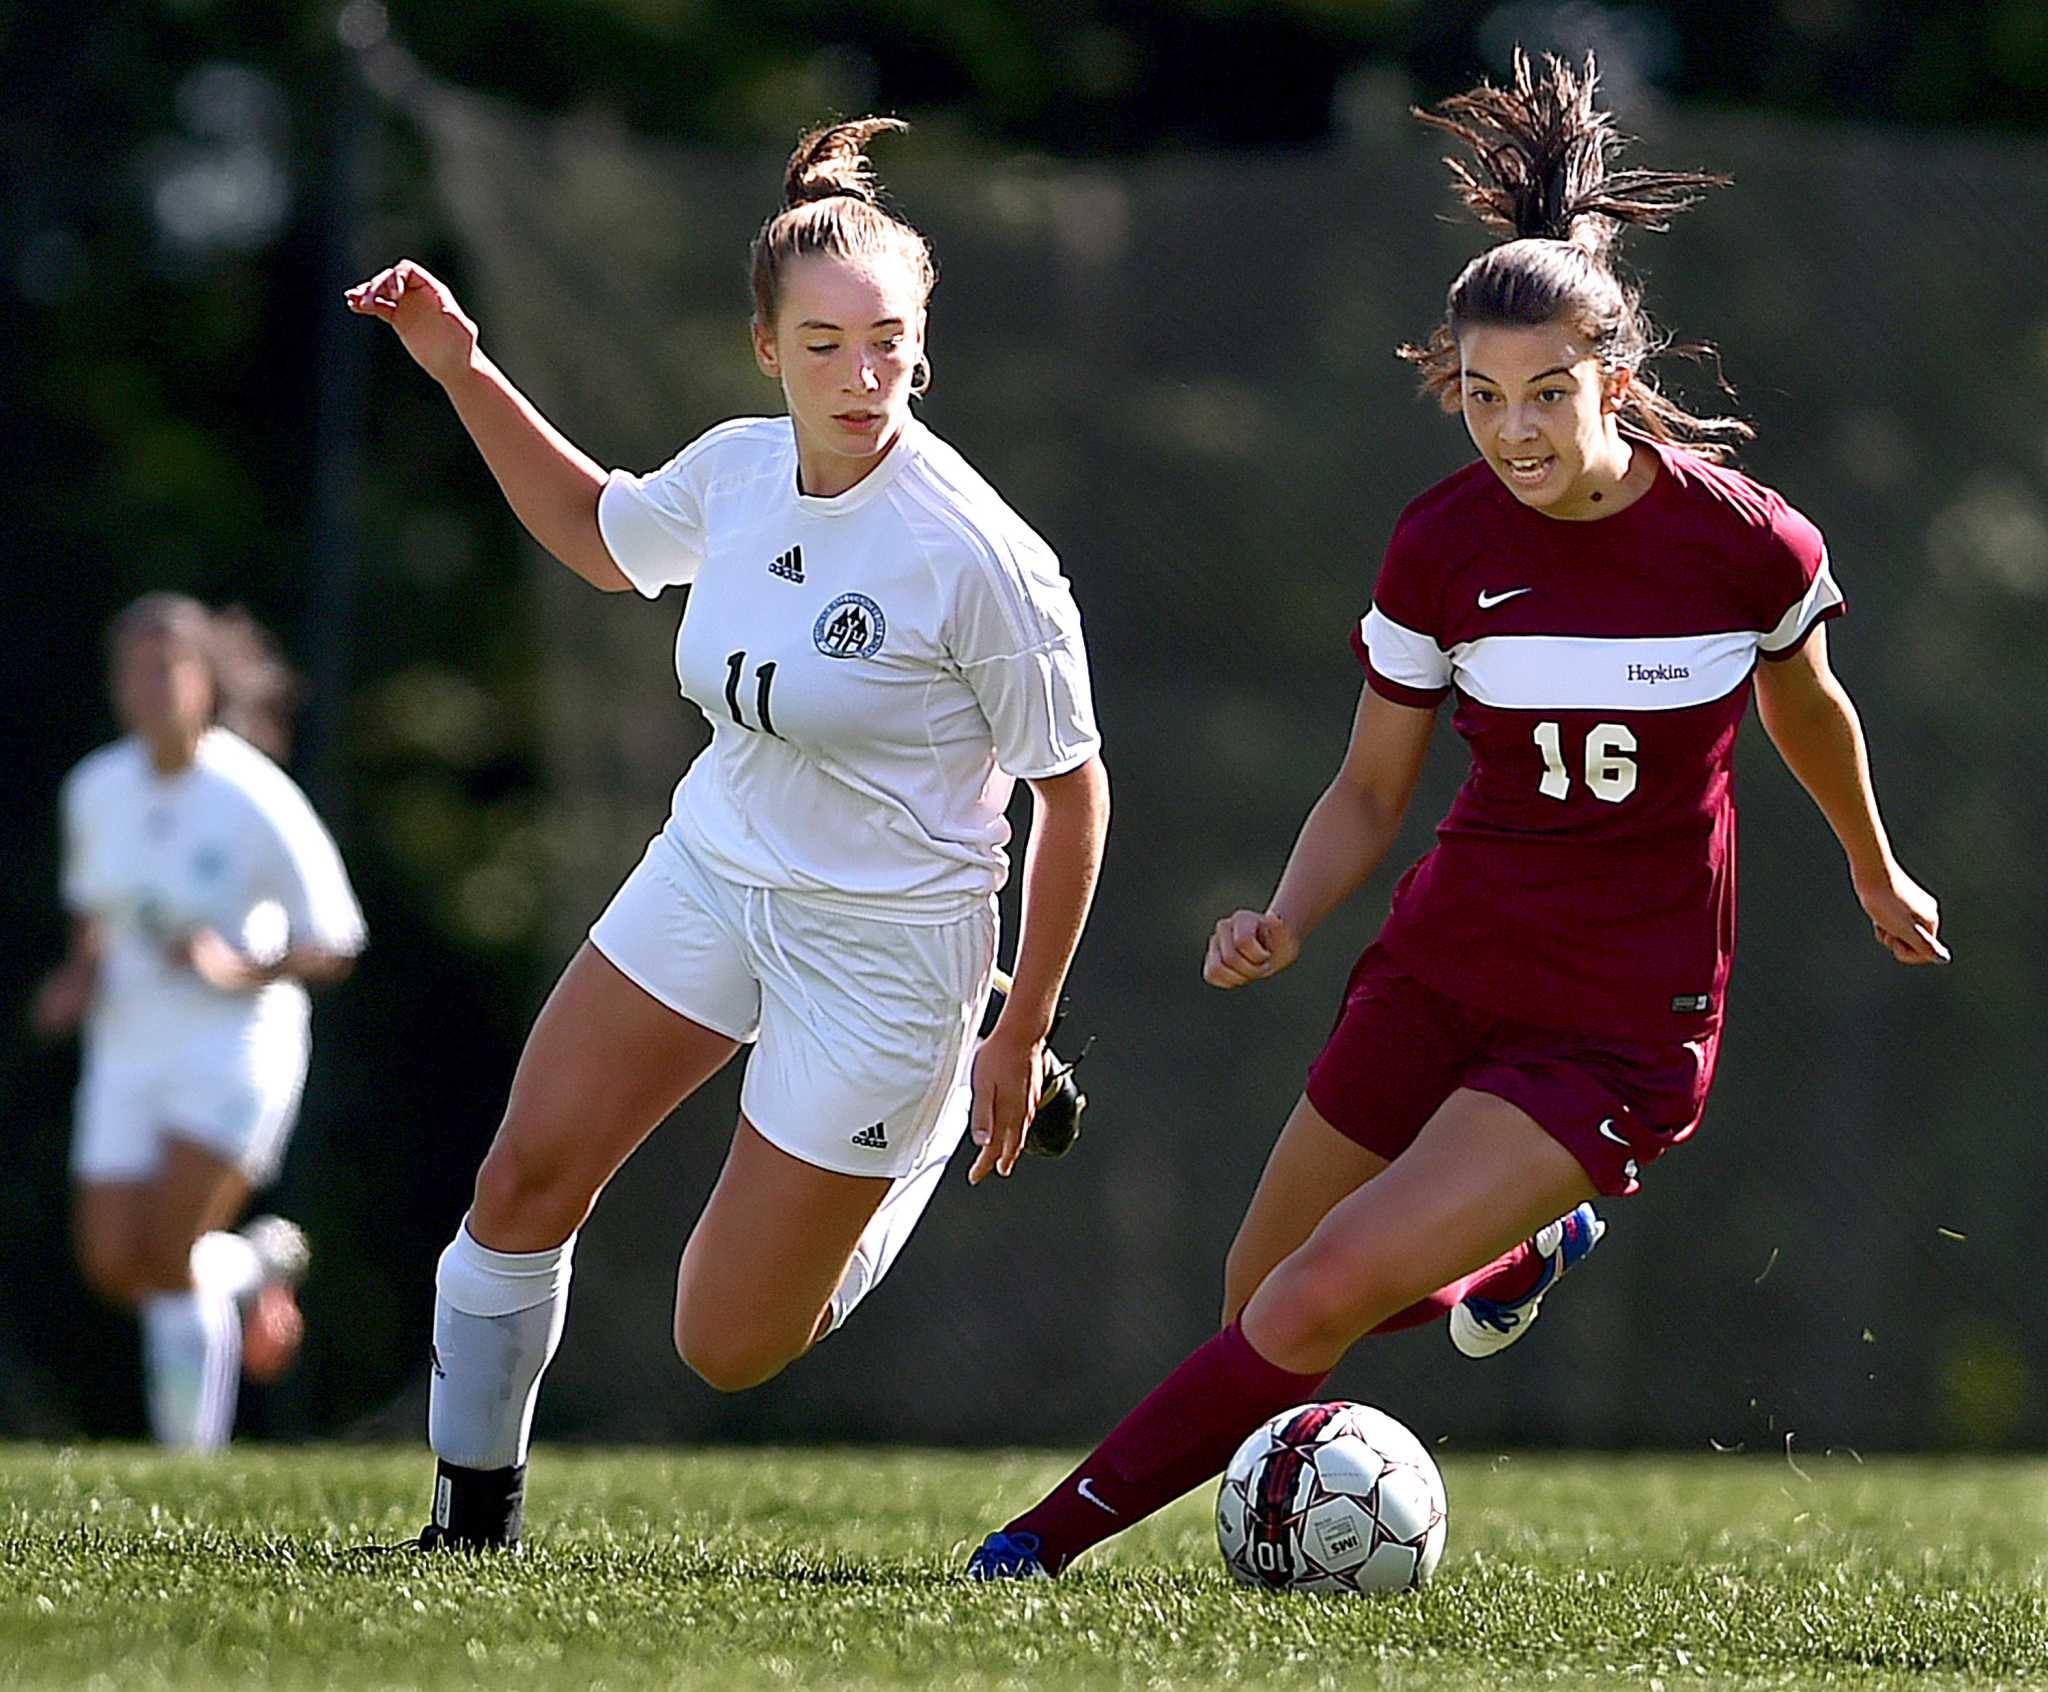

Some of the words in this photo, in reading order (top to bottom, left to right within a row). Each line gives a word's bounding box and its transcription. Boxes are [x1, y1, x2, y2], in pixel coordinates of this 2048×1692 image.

[725, 651, 784, 739] 11
[1627, 663, 1690, 684] Hopkins
[1533, 721, 1637, 803] 16
[1330, 1535, 1358, 1554] IMS
